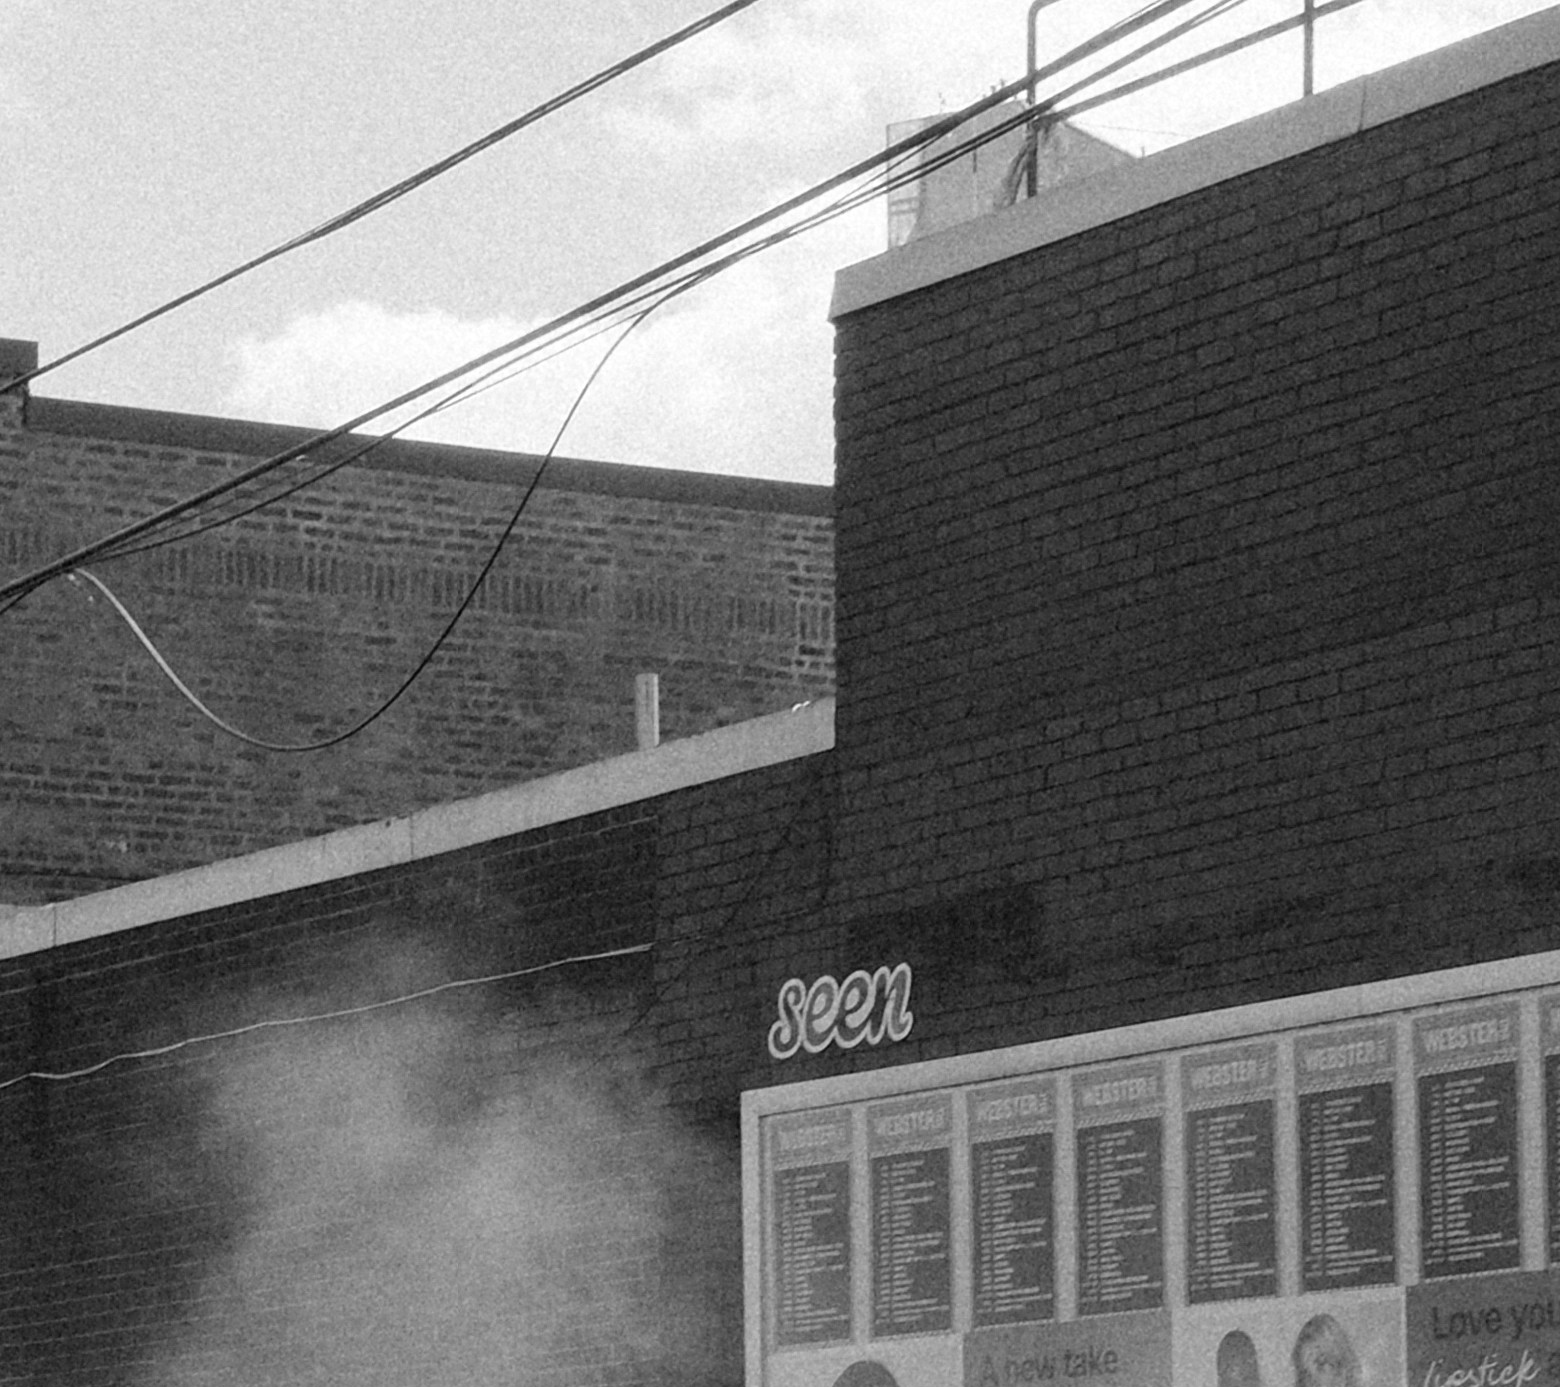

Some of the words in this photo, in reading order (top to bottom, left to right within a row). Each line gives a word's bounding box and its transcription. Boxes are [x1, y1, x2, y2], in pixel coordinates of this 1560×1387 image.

[767, 961, 914, 1060] seen
[1432, 1305, 1502, 1341] Love
[981, 1354, 999, 1387] A
[1004, 1355, 1056, 1384] new
[1063, 1345, 1118, 1378] take
